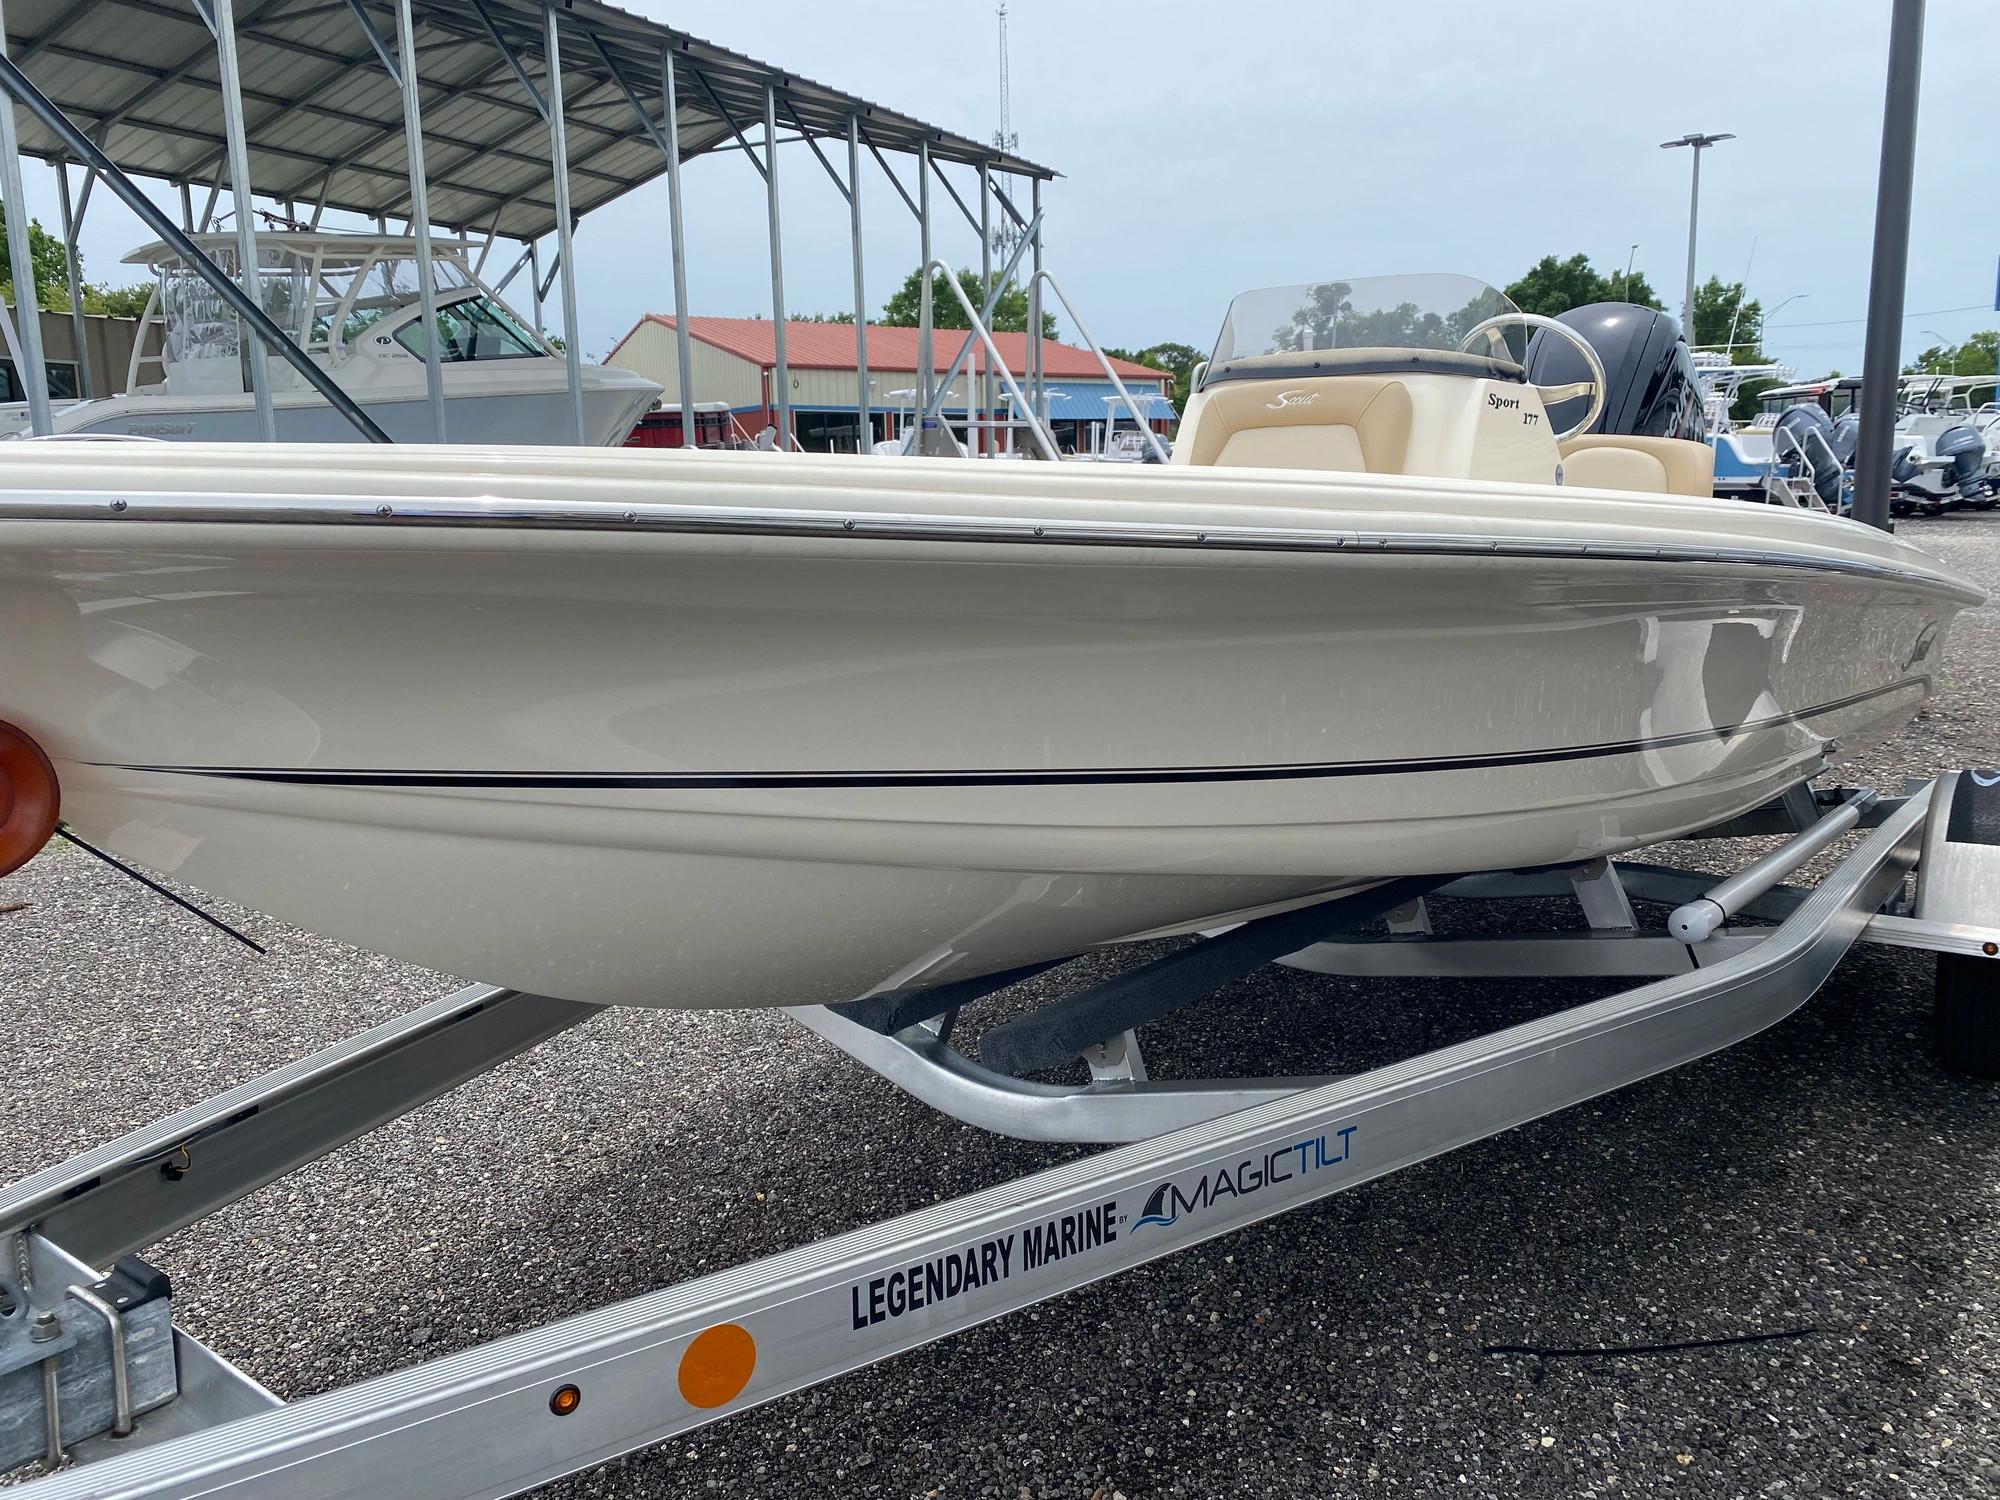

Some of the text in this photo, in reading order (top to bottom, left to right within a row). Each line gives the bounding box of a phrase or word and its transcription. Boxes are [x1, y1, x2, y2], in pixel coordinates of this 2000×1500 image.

[1265, 389, 1321, 410] Scout
[1488, 392, 1520, 410] Sport
[1523, 412, 1539, 426] 177
[1171, 1125, 1358, 1219] MAGICTILT
[852, 1201, 1129, 1331] LEGENDARY MARINE BY
